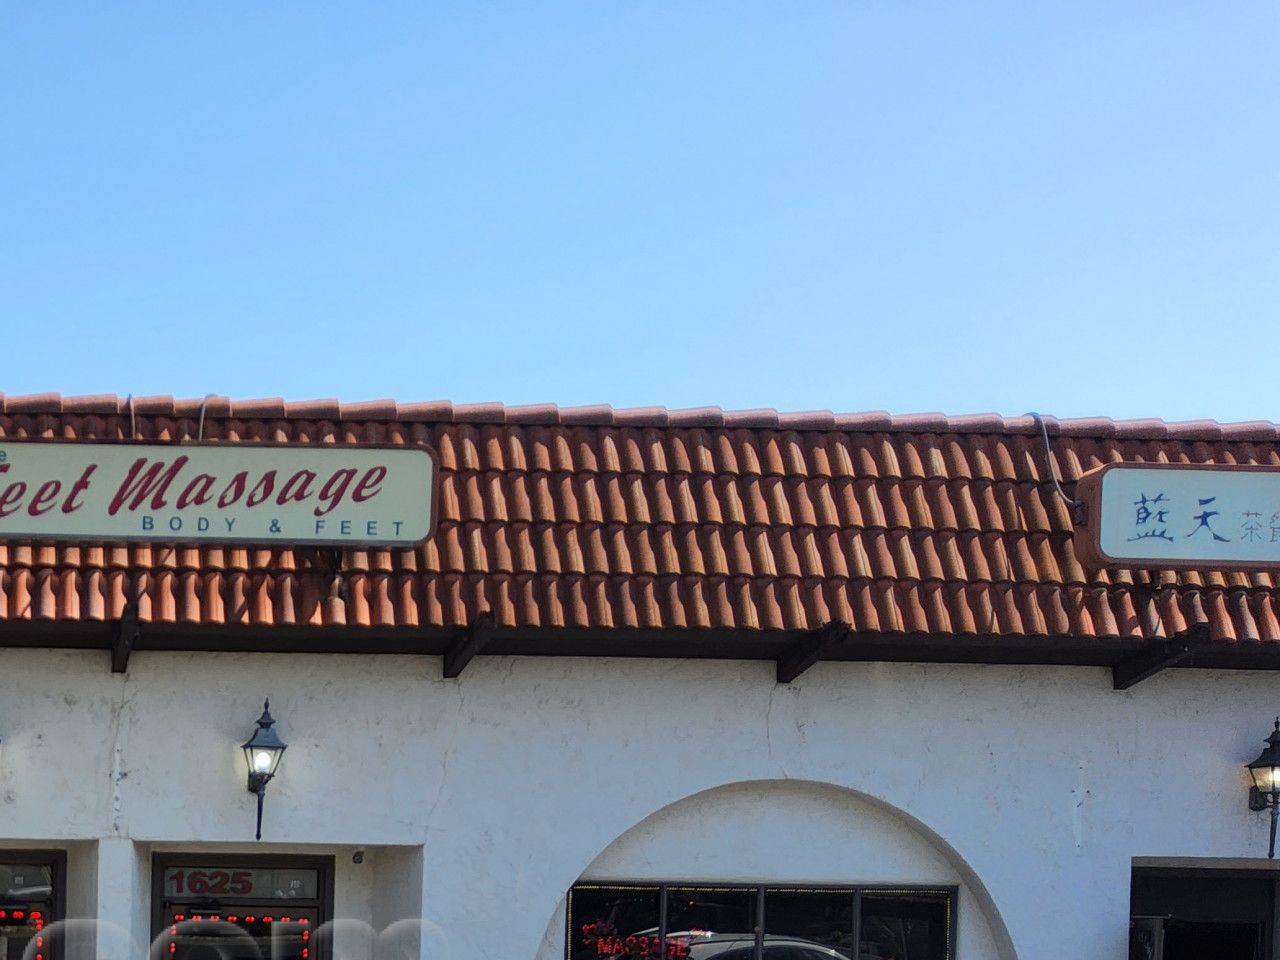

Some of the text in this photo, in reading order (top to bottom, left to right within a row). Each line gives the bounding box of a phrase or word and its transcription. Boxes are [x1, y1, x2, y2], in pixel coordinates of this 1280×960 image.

[108, 455, 387, 516] Massage
[142, 516, 404, 536] BODY & FEET
[169, 869, 253, 895] 1625
